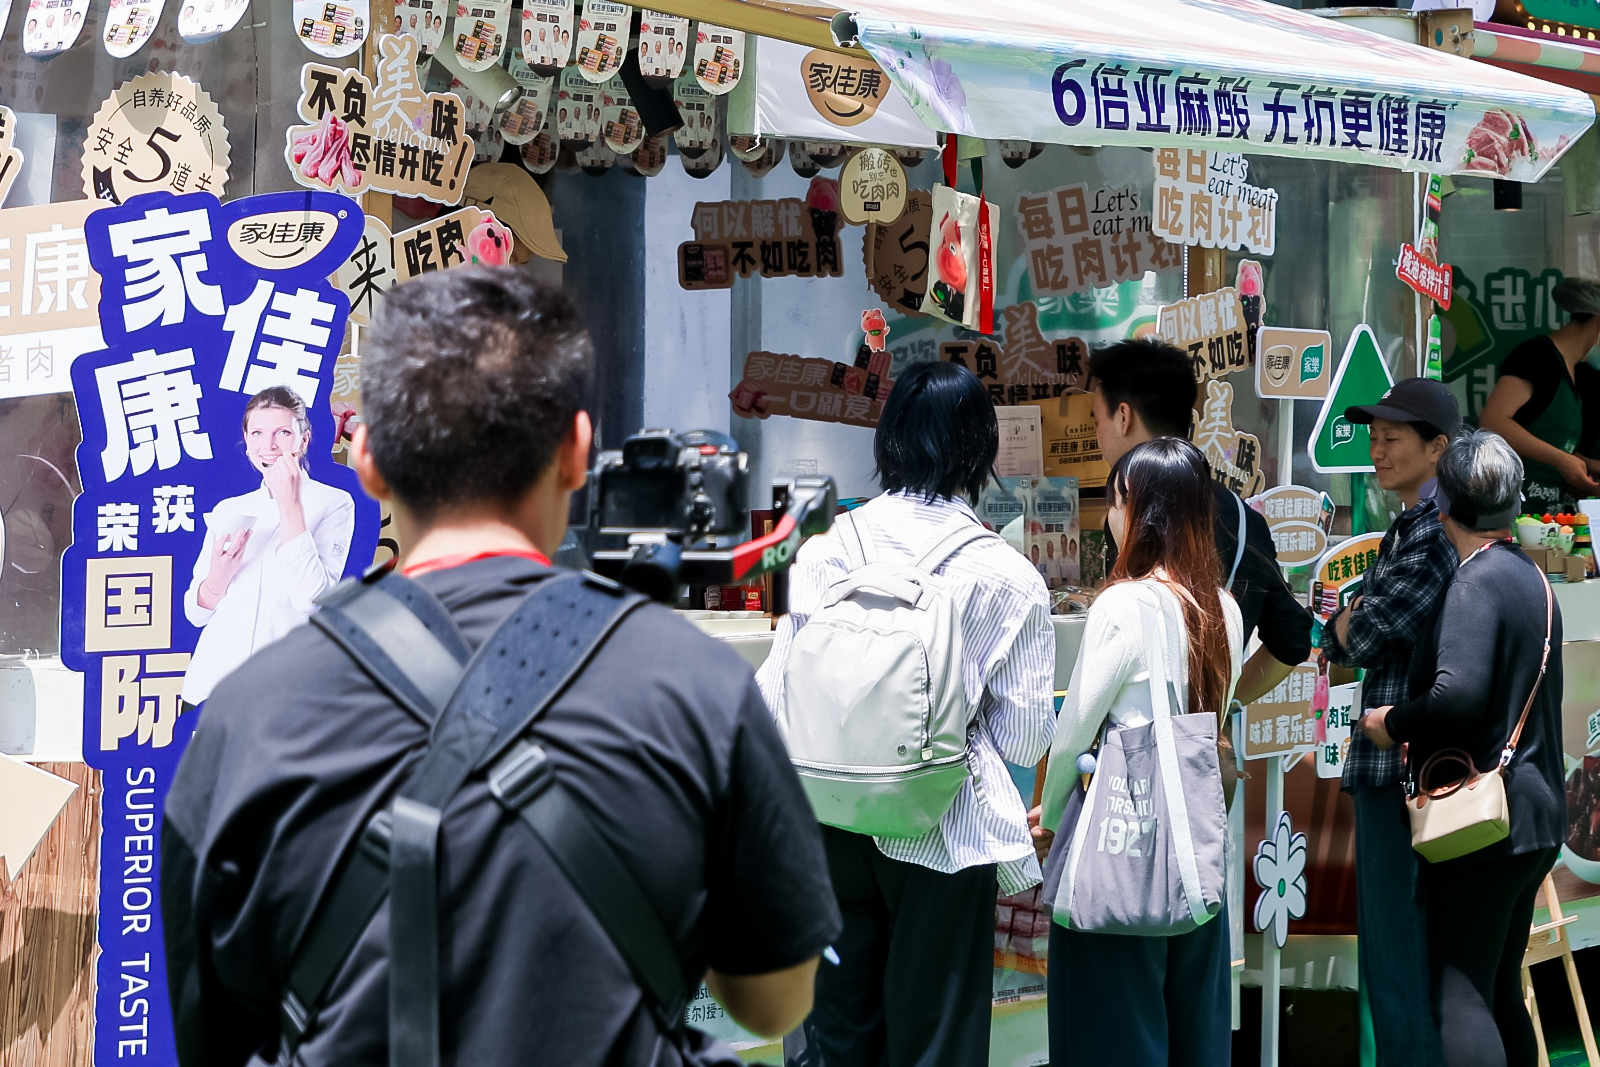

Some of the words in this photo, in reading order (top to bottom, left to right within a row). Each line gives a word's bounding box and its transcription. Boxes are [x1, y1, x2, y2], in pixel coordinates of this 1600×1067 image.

[808, 62, 882, 100] 家佳康
[132, 87, 213, 135] 自养好品质
[1050, 58, 1254, 142] 6倍亚麻酸
[1262, 80, 1448, 163] 无抗更健康
[1157, 147, 1207, 185] 每日
[1209, 151, 1248, 180] Let's
[1018, 186, 1090, 241] 每日
[1091, 188, 1139, 214] Let's
[1208, 175, 1233, 199] eat
[1236, 181, 1276, 213] meat
[239, 220, 326, 245] 家佳康
[694, 202, 804, 241] 何以解忧
[1093, 213, 1124, 237] eat
[1157, 185, 1273, 249] 吃肉计划
[731, 238, 839, 275] 不如吃肉
[1030, 229, 1186, 294] 吃肉计划
[1159, 293, 1238, 346] 何以解忧
[747, 355, 828, 386] 家佳康
[762, 391, 881, 423] 一口就爱
[97, 484, 195, 553] 荣获
[84, 555, 192, 752] 国际
[122, 767, 156, 936] SUPERIOR
[118, 952, 149, 1059] TASTE
